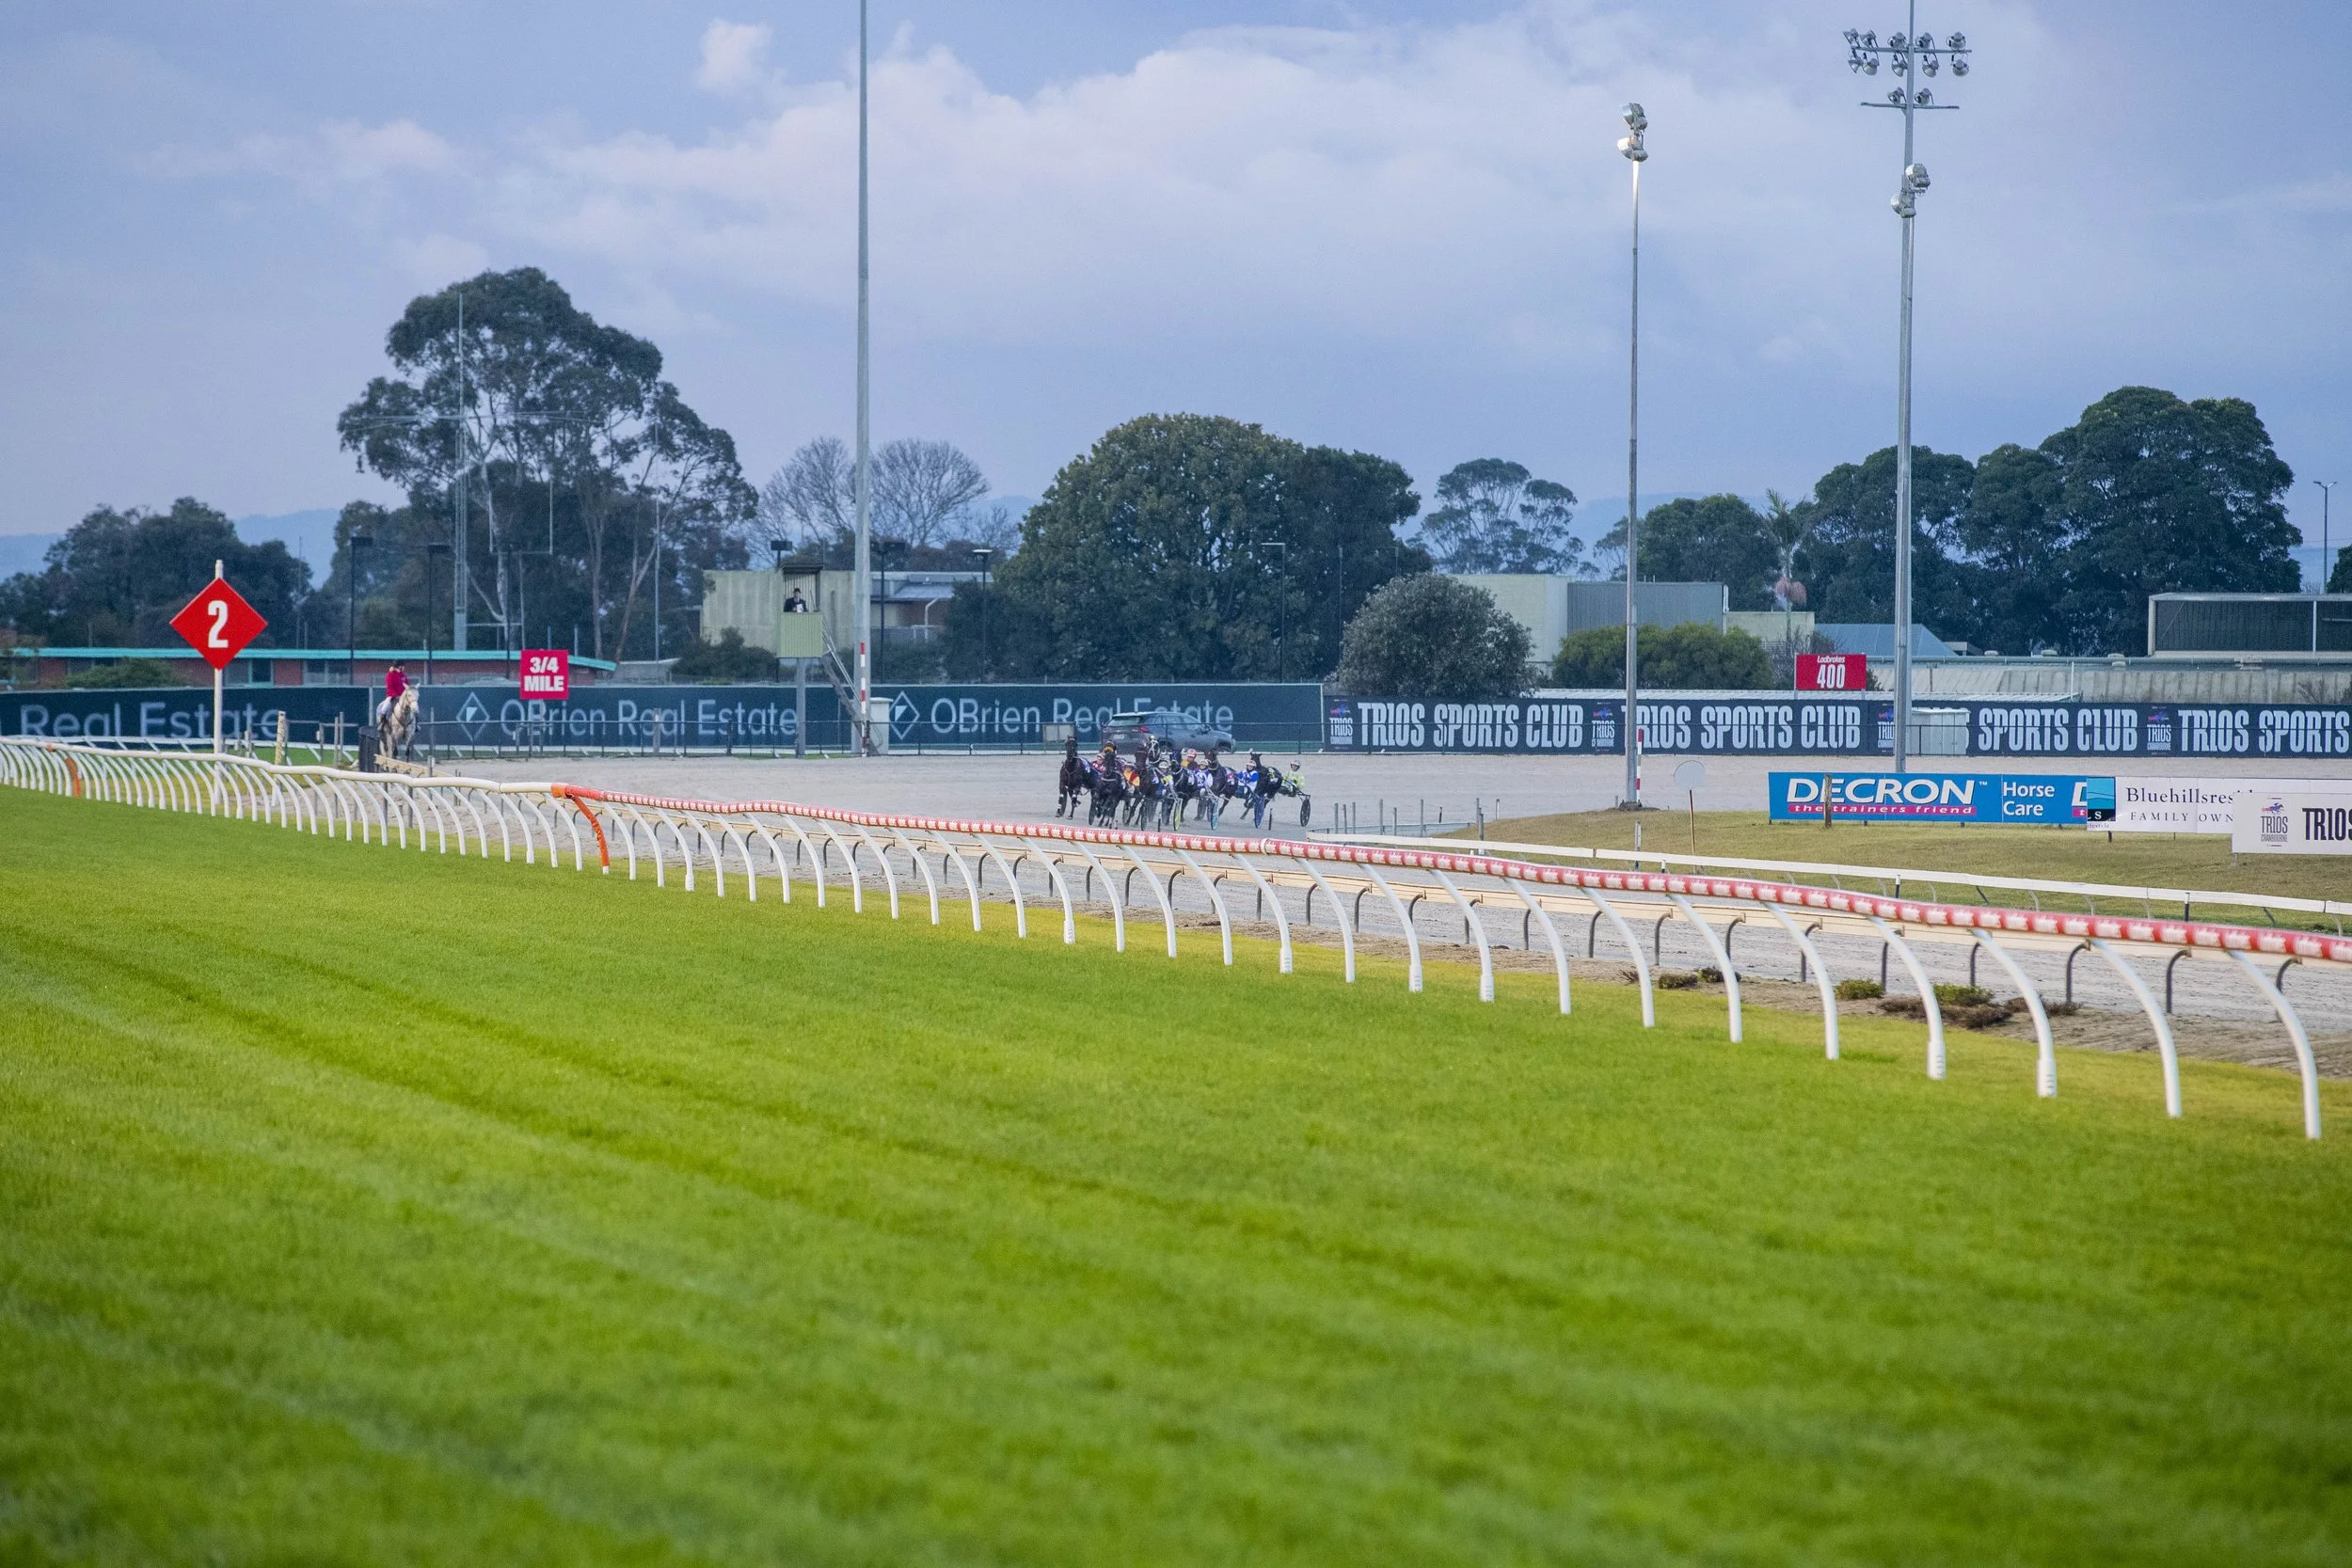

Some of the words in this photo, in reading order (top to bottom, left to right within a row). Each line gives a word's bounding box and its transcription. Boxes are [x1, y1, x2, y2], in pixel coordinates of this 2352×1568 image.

[208, 600, 229, 648] 2
[530, 657, 560, 673] 3/4
[1817, 656, 1846, 664] Ladbrokes
[523, 675, 564, 691] MILE
[1817, 664, 1846, 689] 400
[21, 703, 120, 736] Real
[501, 699, 606, 736] OBrien
[618, 699, 685, 736] Real
[698, 699, 798, 736] Estate
[931, 698, 1041, 734] OBrien
[1329, 718, 1353, 736] TRIOS
[1358, 703, 1425, 747] TRIOS
[1433, 704, 1519, 748] SPORTS
[1526, 705, 1583, 748] CLUB
[1592, 721, 1614, 738] TRIOS
[1621, 705, 1691, 749] RIOS
[1701, 705, 1792, 749] SPORTS
[1802, 705, 1861, 749] CLUB
[1878, 721, 1894, 739] TRIO
[1979, 707, 2069, 752] SPORTS
[2077, 708, 2137, 752] CLUB
[2147, 724, 2171, 742] TRIOS
[2178, 710, 2249, 752] TRIOS
[2259, 711, 2350, 752] SPORTS
[1787, 778, 1975, 804] DECRON
[2003, 782, 2055, 798] Horse
[2126, 787, 2252, 804] Bluehillsres
[1915, 806, 1972, 815] friend
[2003, 800, 2044, 816] Care
[2130, 812, 2188, 822] FAMILY
[2261, 816, 2288, 833] TRIOS
